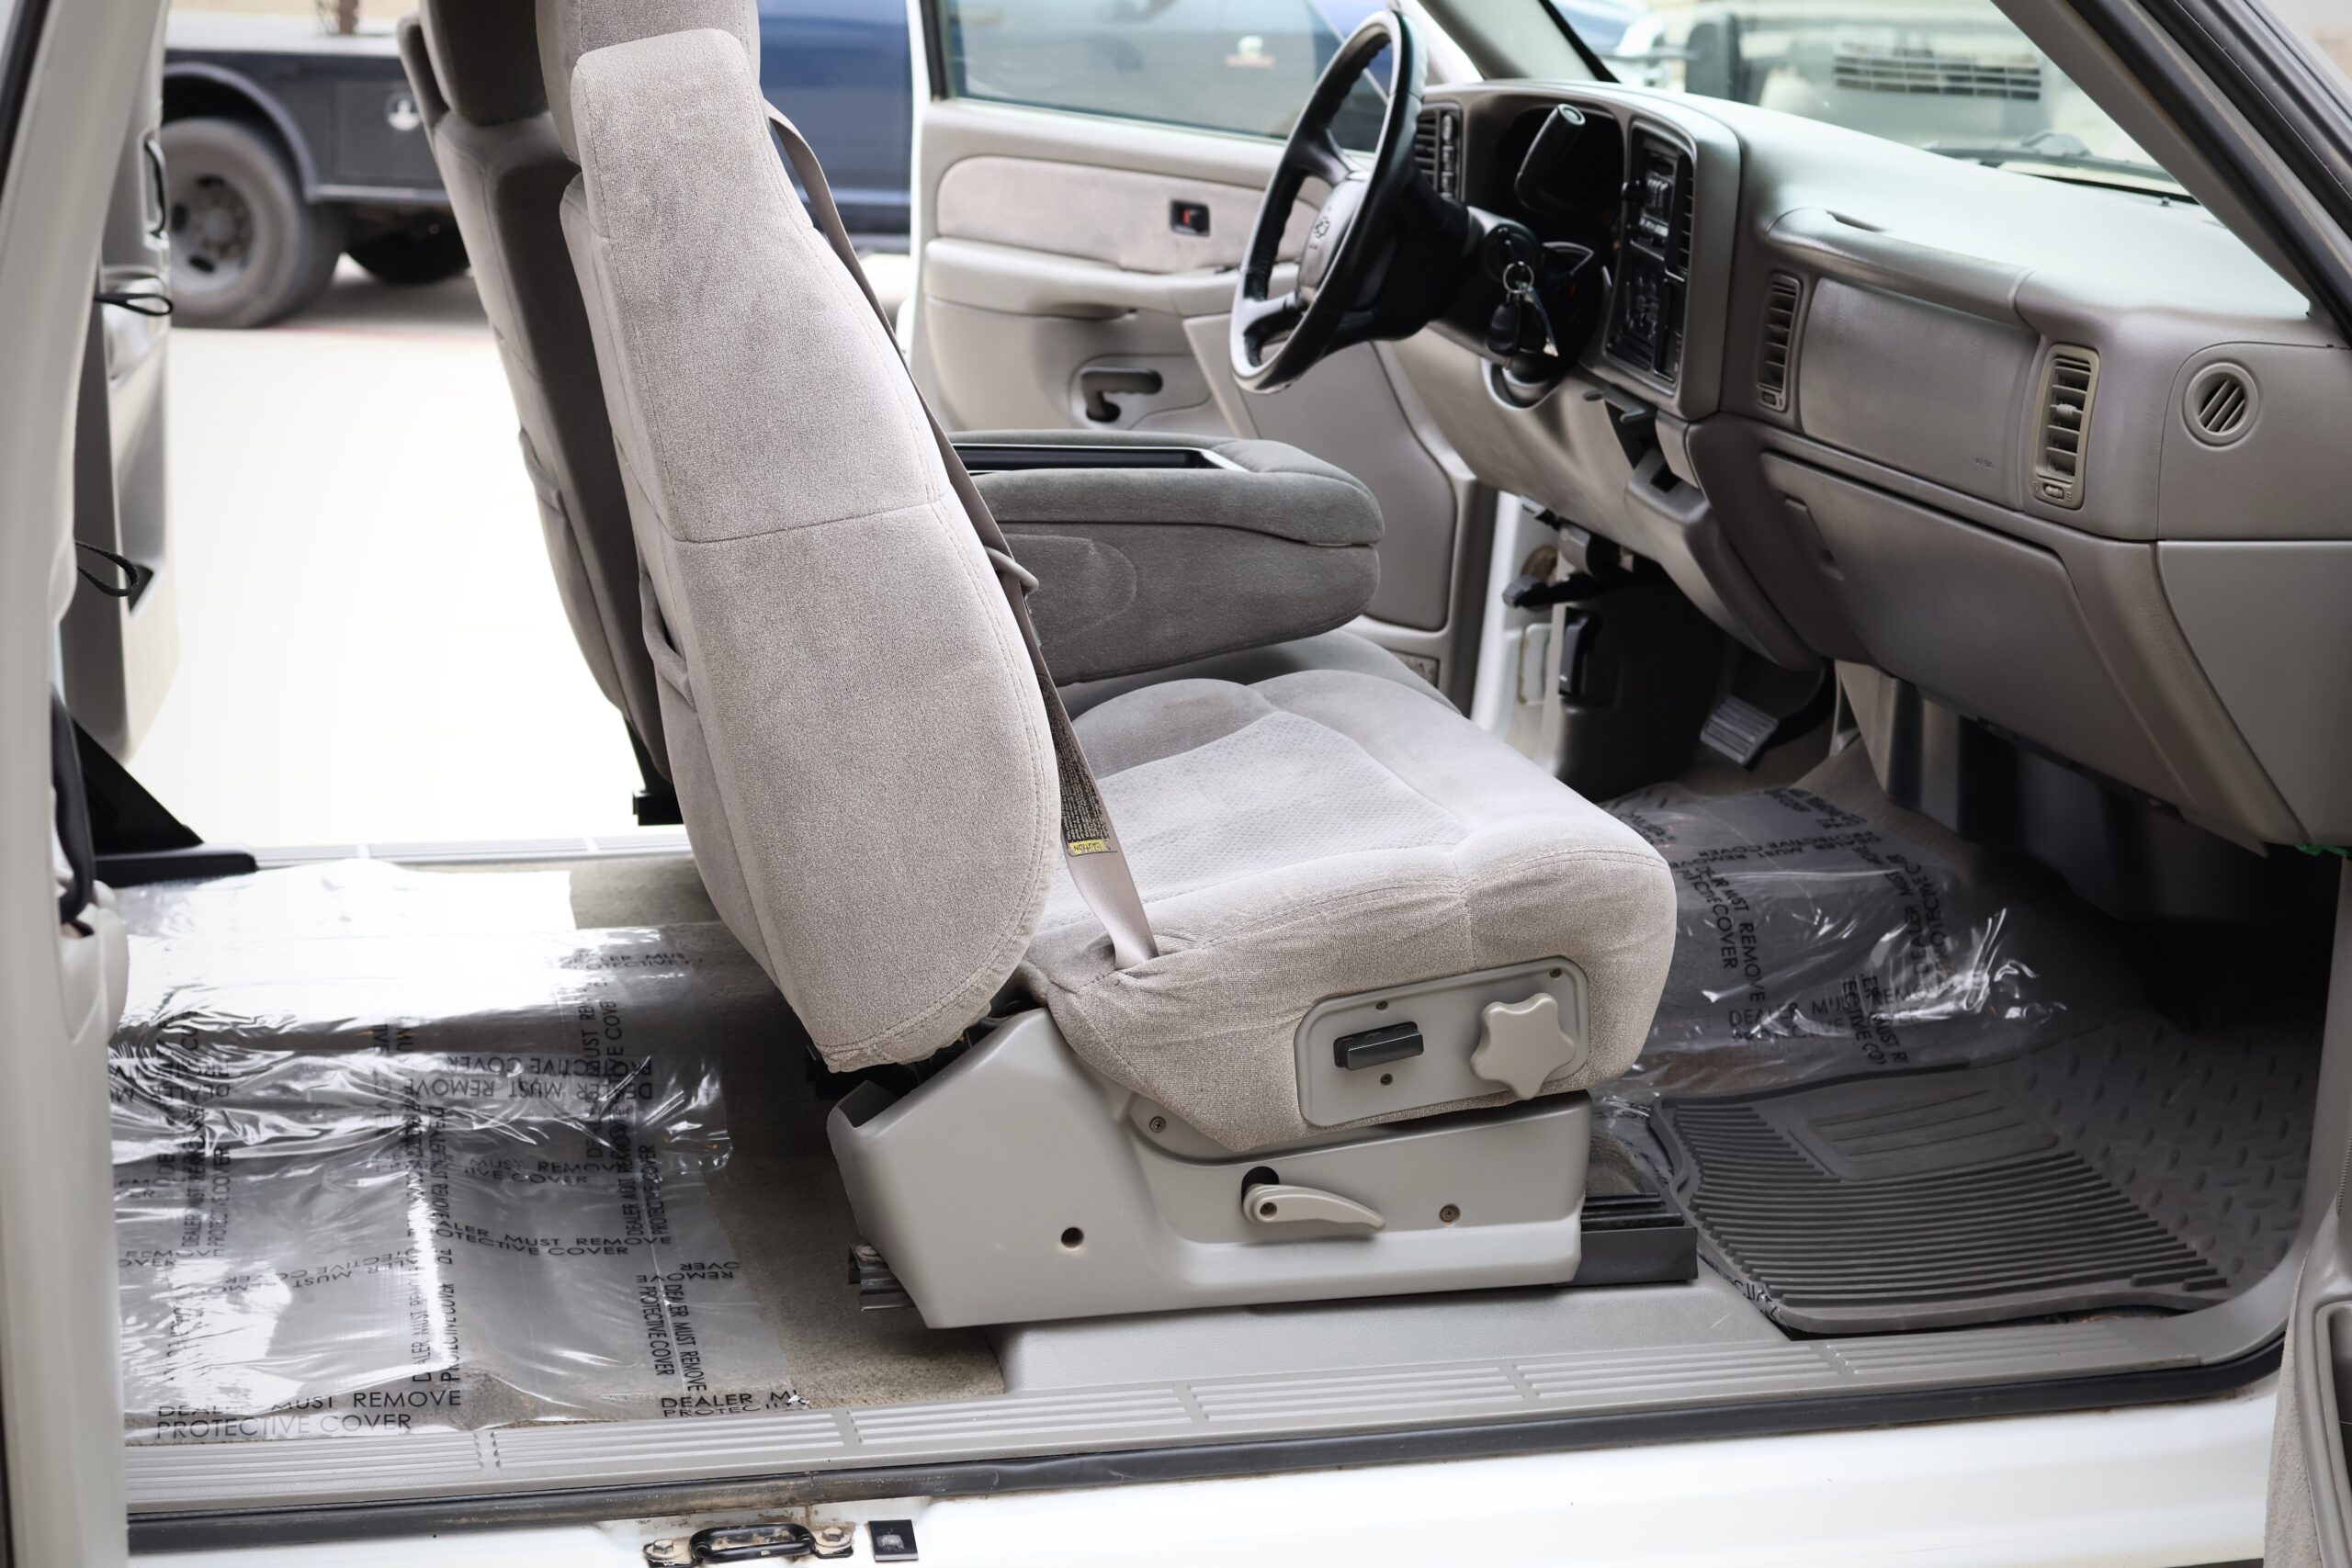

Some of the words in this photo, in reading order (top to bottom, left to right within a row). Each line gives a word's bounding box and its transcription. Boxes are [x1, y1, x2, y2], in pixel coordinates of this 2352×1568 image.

[1713, 904, 1739, 969] COVER
[1739, 922, 1765, 1002] REMOVE
[447, 1055, 522, 1073] COVER
[509, 1077, 562, 1099] MUST
[180, 1213, 201, 1247] DEALER
[622, 1203, 644, 1236] DEALER
[503, 1234, 560, 1247] MUST
[575, 1235, 672, 1247] REMOVE
[548, 1247, 628, 1256] COVER
[292, 1270, 352, 1290] MUST
[635, 1271, 734, 1284] REMOVE
[409, 1309, 430, 1337] MUST
[638, 1285, 668, 1339] PROTECTIVE
[673, 1321, 696, 1347] MUST
[410, 1340, 433, 1382] DALER
[650, 1339, 675, 1376] COVER
[679, 1350, 707, 1392] REMOVE
[270, 1394, 335, 1413] MUST
[352, 1389, 462, 1409] REMOVE
[661, 1393, 754, 1408] DEALER
[154, 1415, 311, 1440] PROTECTIVE
[319, 1413, 413, 1434] COVER
